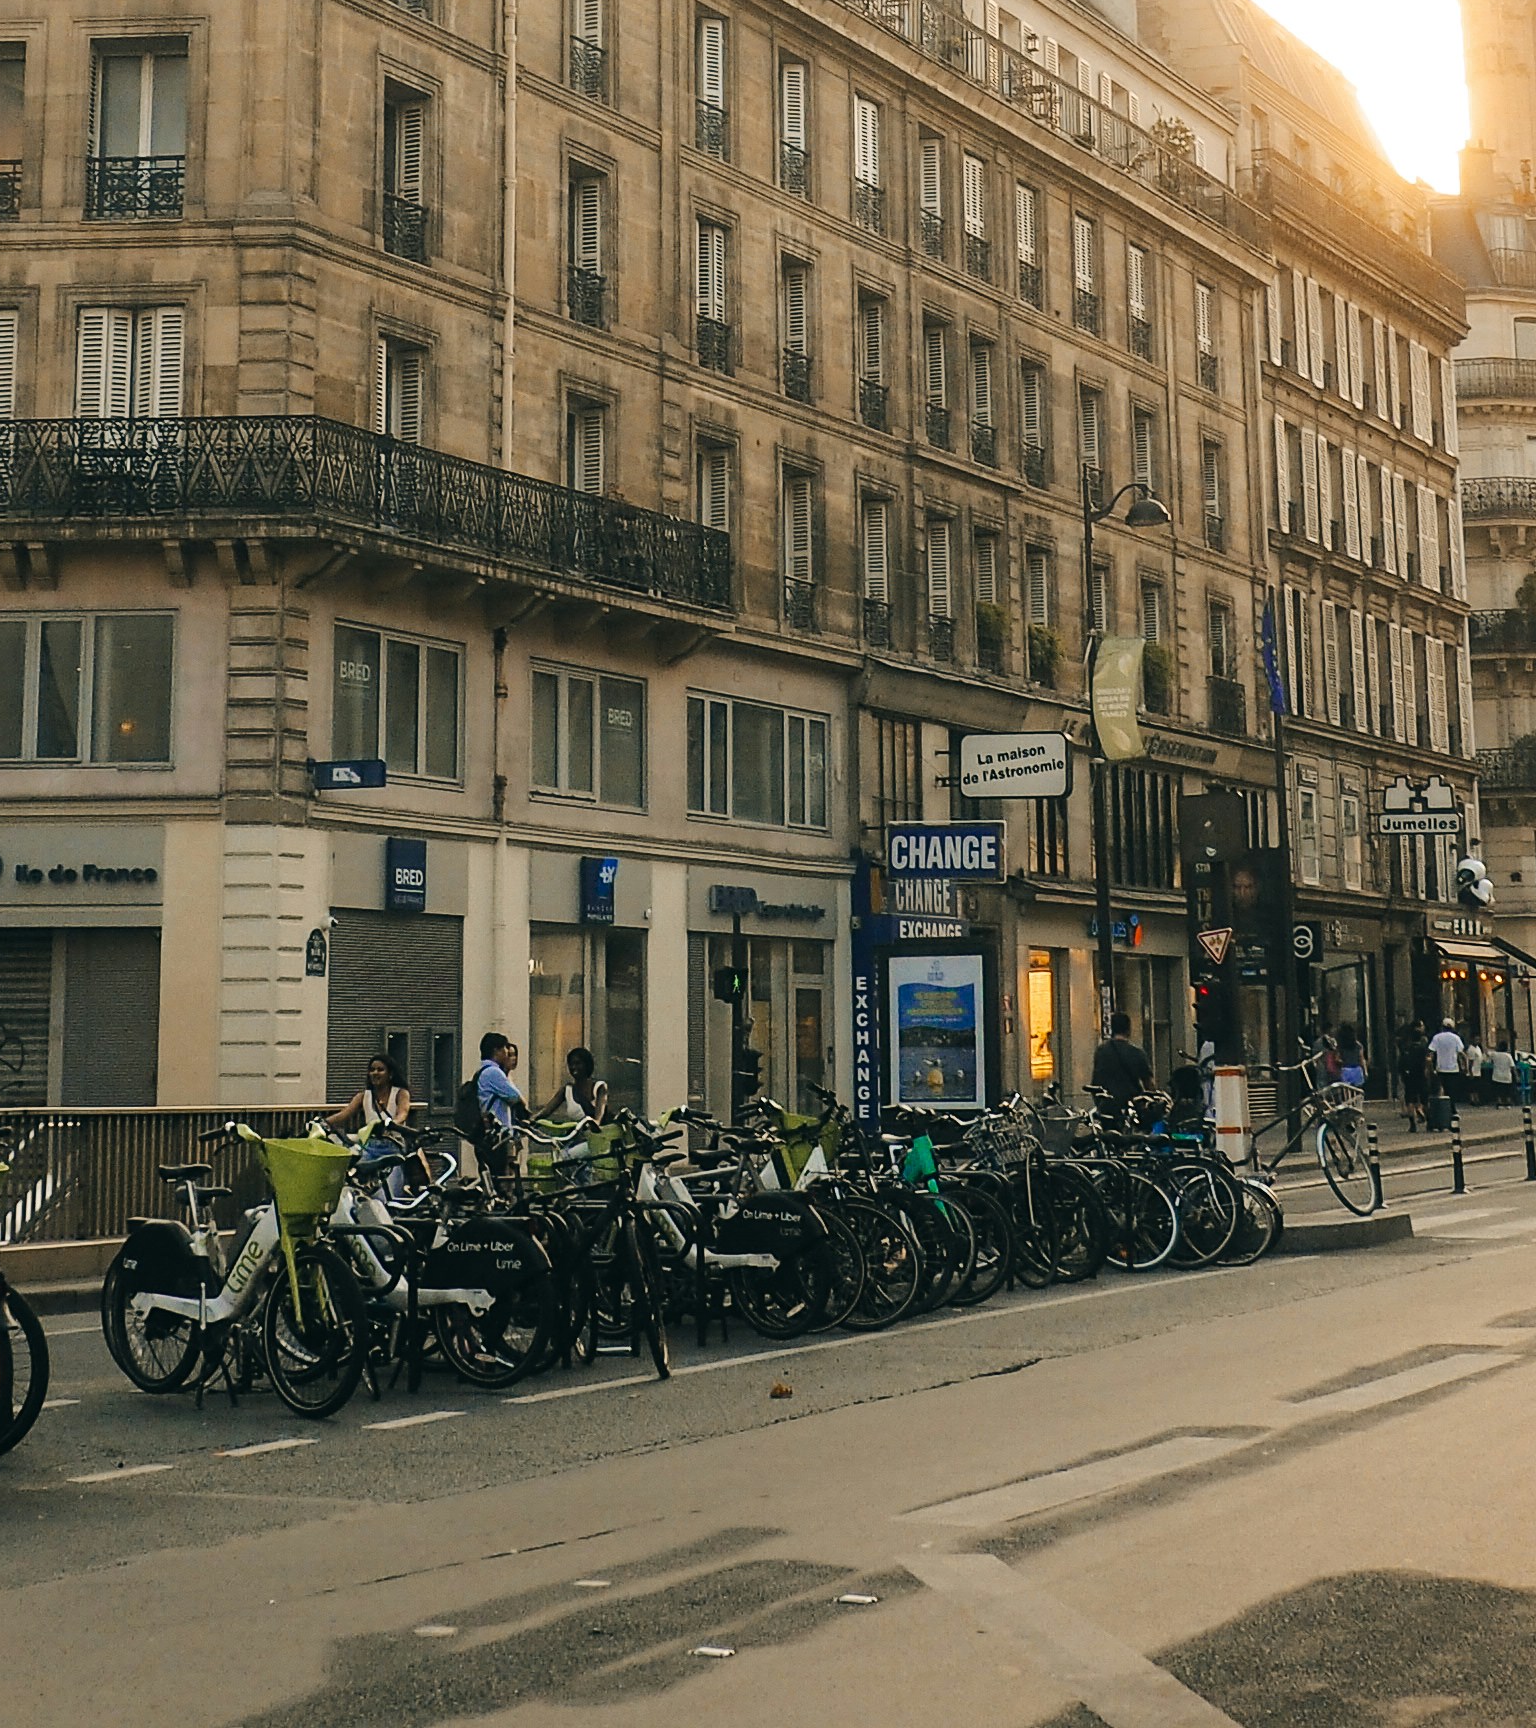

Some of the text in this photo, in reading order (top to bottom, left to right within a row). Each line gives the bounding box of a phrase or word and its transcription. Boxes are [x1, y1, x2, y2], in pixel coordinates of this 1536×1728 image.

[340, 661, 370, 681] BRED
[608, 708, 632, 727] BRED
[977, 745, 1046, 766] La maison
[963, 758, 1065, 785] de l'Astronomie
[1382, 818, 1458, 832] Jumelles
[891, 835, 997, 870] CHANGE
[48, 863, 78, 883] de
[82, 863, 158, 883] France
[395, 868, 424, 886] BRED
[895, 879, 951, 914] CHANGE
[900, 921, 962, 939] EXCHANGE
[855, 976, 871, 1119] EXCHANGE
[742, 1209, 754, 1219] On
[754, 1209, 774, 1220] Lime
[780, 1211, 802, 1222] Uber
[447, 1241, 459, 1252] On
[460, 1241, 482, 1252] Lime
[490, 1241, 514, 1252] Uber
[496, 1258, 522, 1270] Lime
